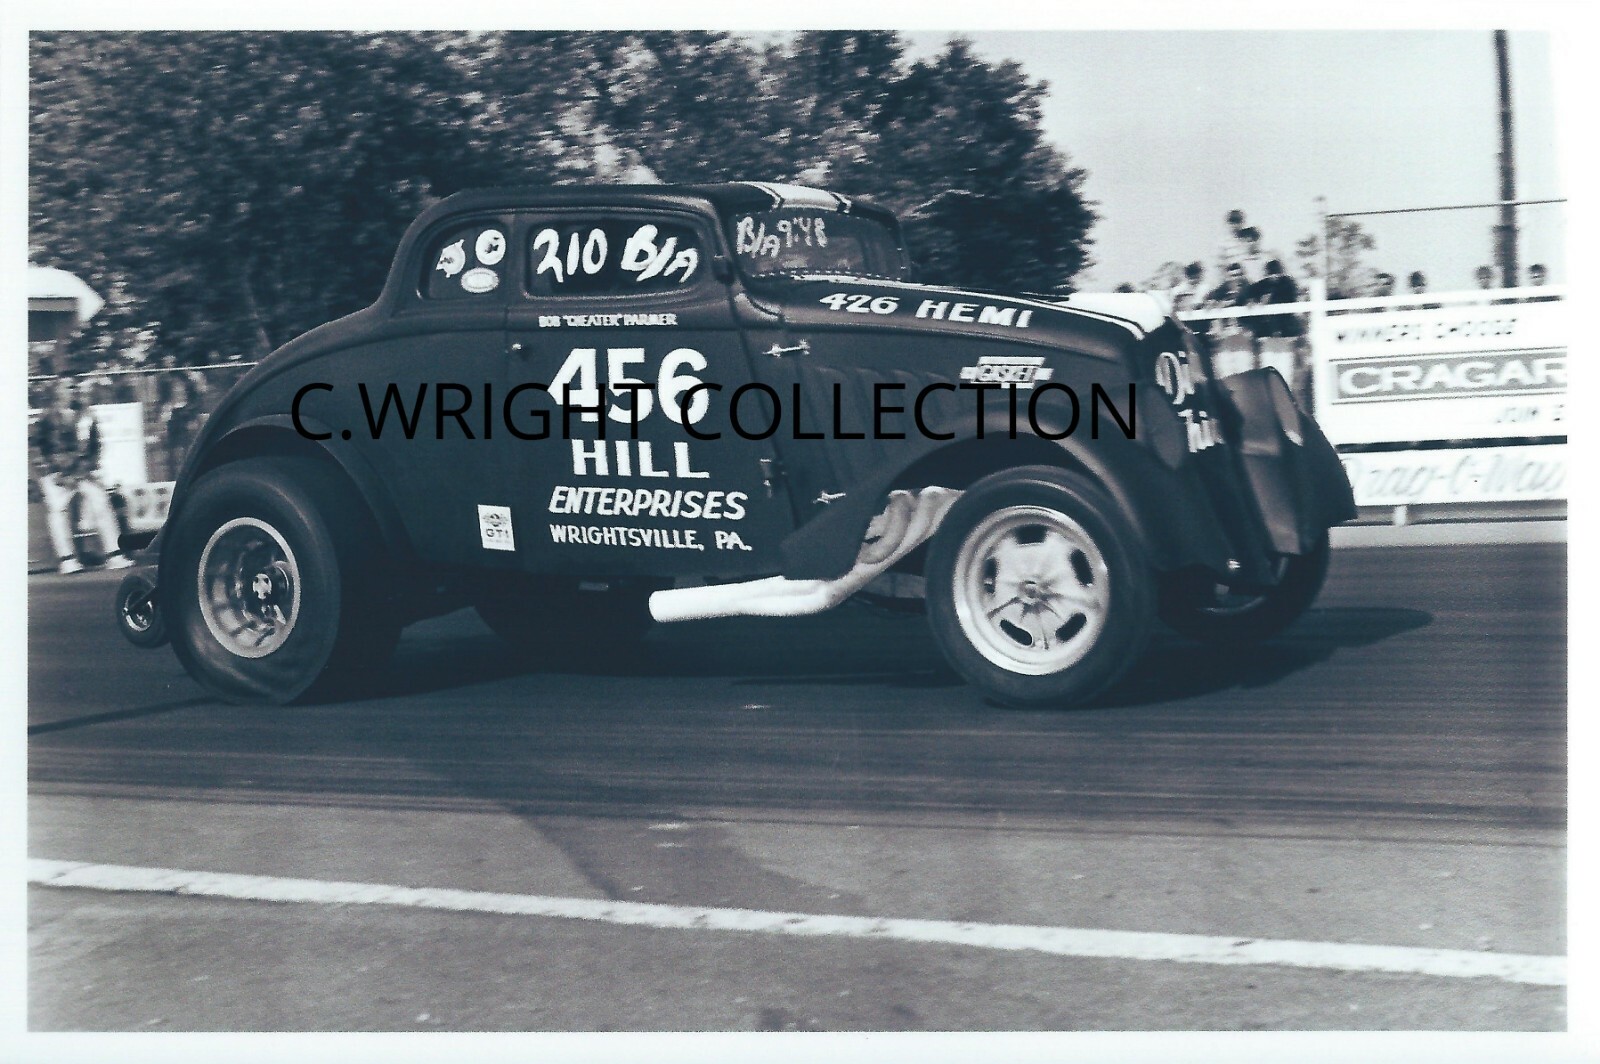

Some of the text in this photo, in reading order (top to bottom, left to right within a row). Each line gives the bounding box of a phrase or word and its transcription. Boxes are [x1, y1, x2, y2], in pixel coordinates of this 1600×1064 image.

[533, 224, 699, 283] 210 B/A
[820, 293, 1033, 328] 426 HEMI
[547, 347, 710, 425] 456
[571, 438, 710, 479] HILL
[548, 485, 749, 520] ENTERPRISES
[549, 524, 753, 552] WRIGHTSVILLE, PA.
